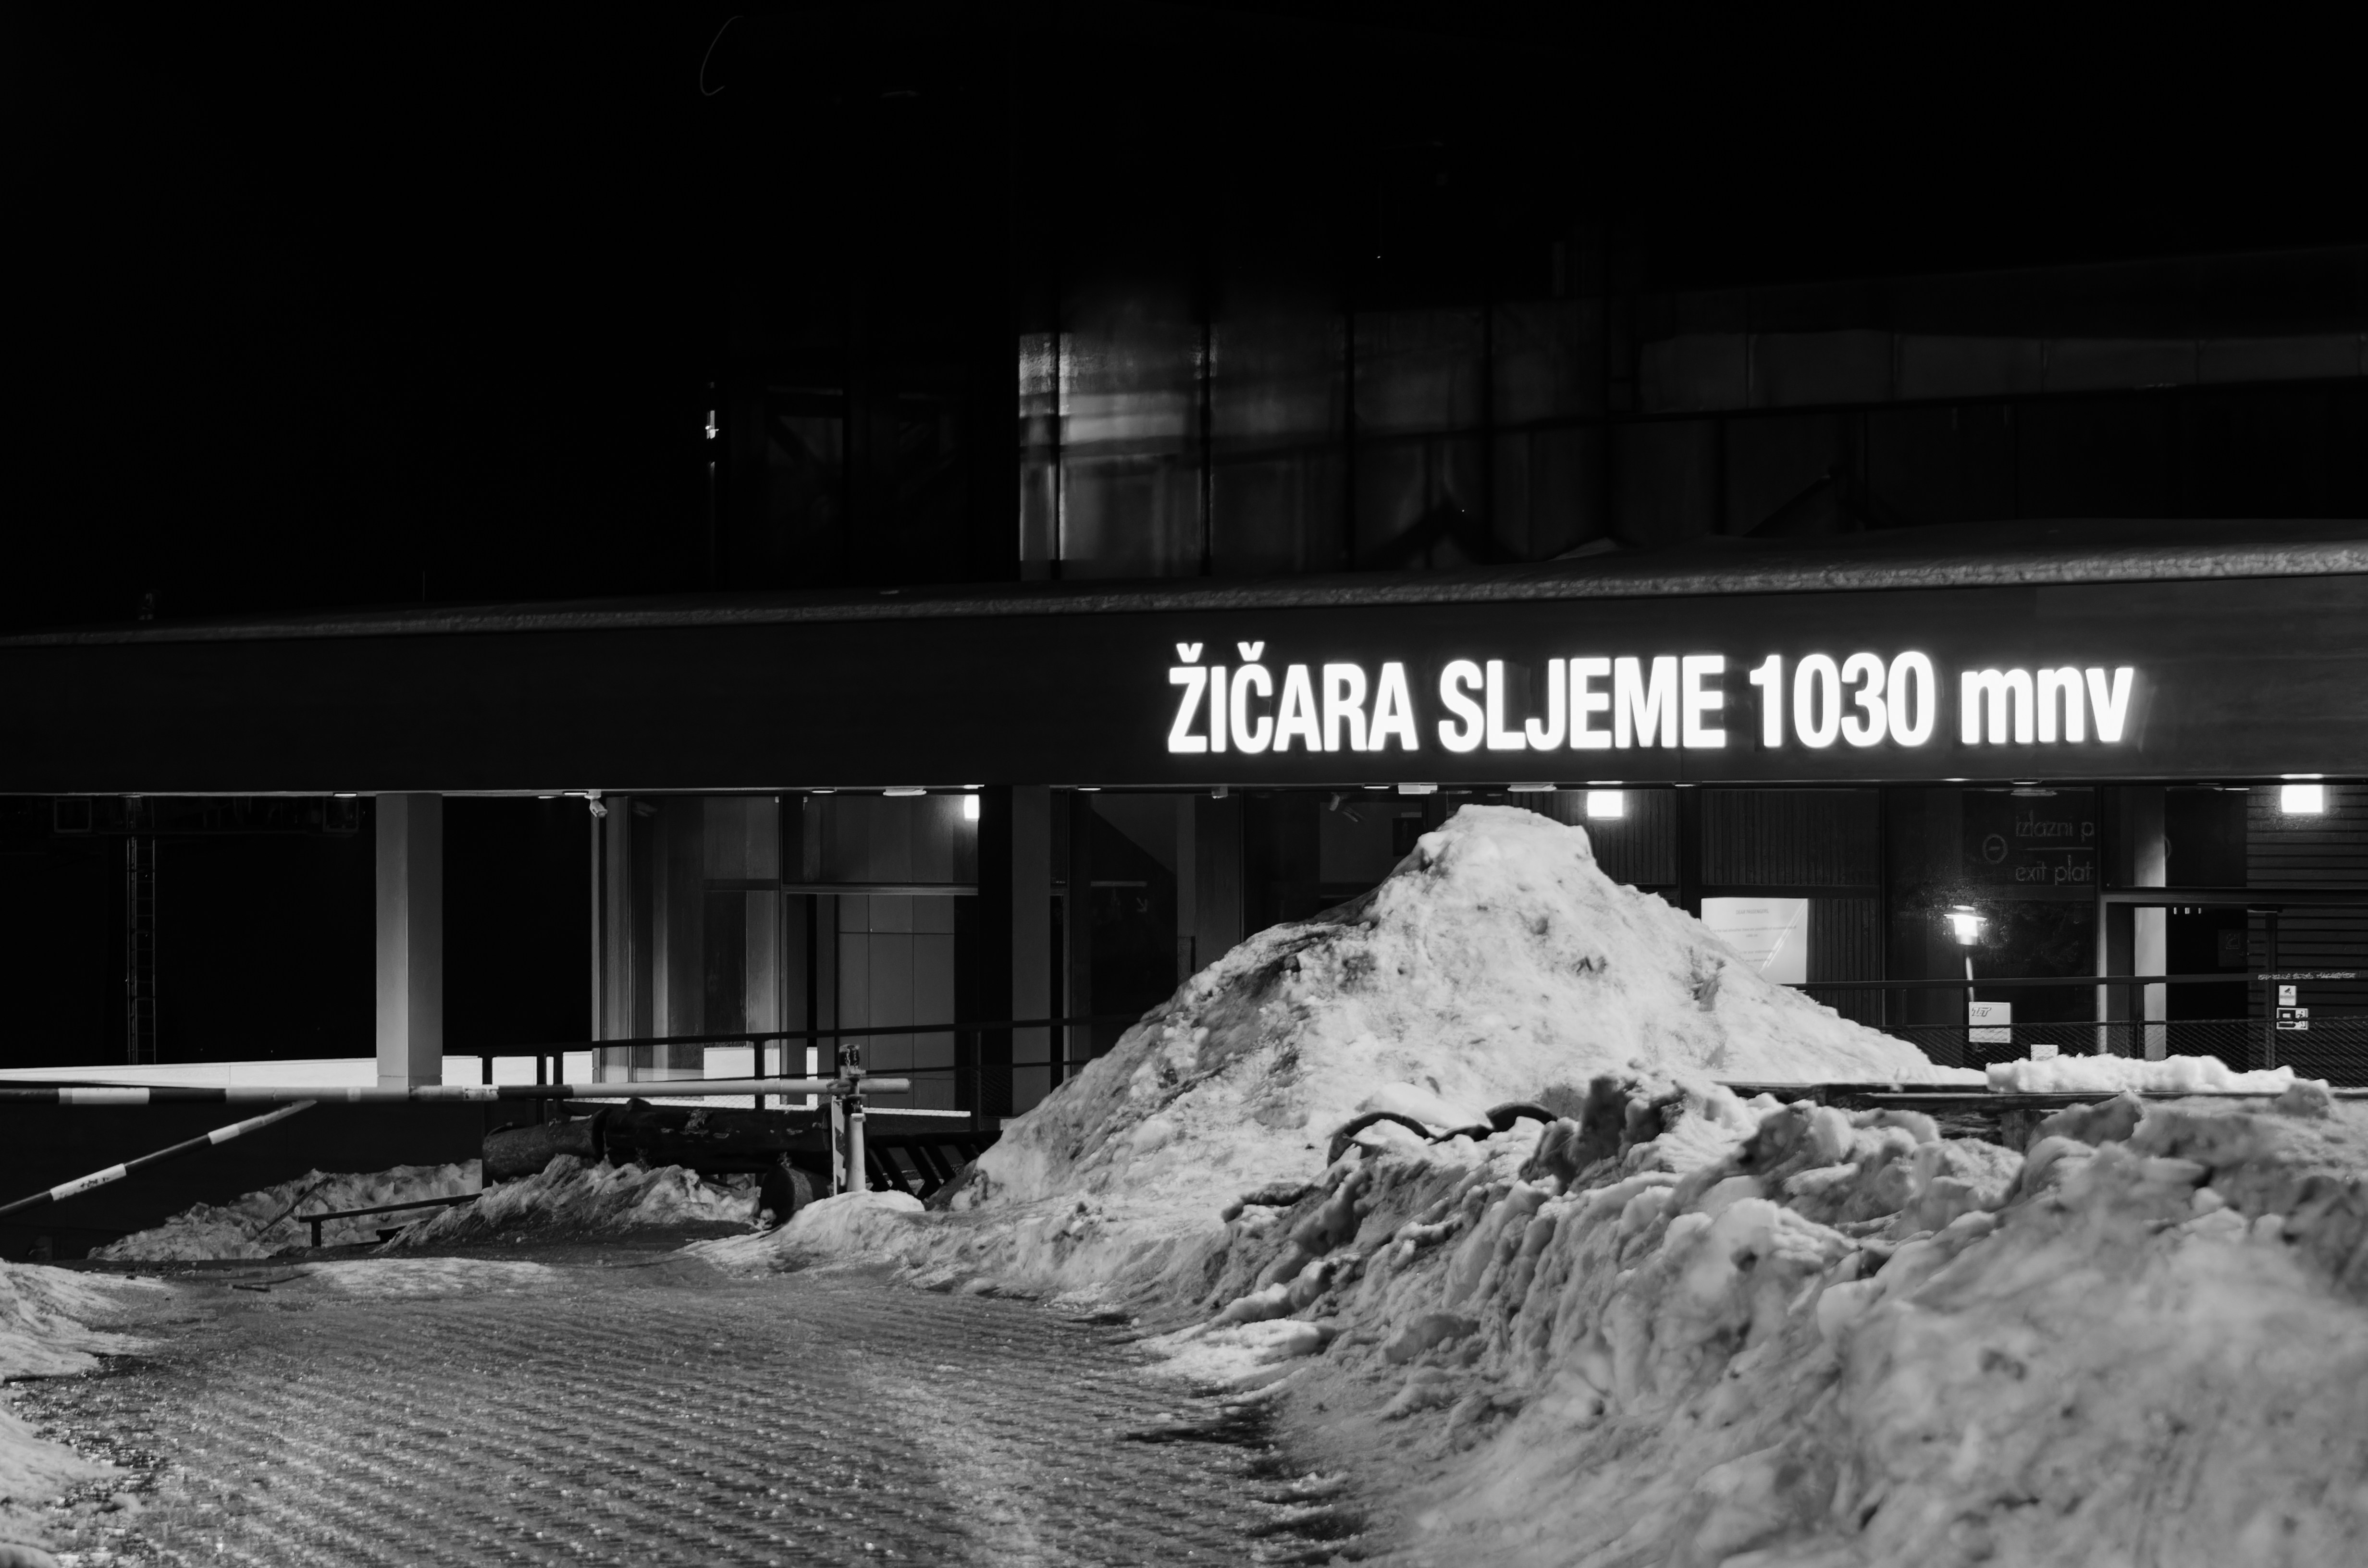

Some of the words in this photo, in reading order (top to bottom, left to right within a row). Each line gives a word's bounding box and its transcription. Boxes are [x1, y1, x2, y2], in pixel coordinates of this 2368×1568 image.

[1168, 641, 1419, 754] ŽIČARA
[1438, 654, 1727, 753] SLJEME
[1749, 649, 1938, 748] 1030
[1960, 664, 2138, 745] mnv
[2016, 809, 2073, 837] izlazni
[2015, 861, 2047, 882] exit
